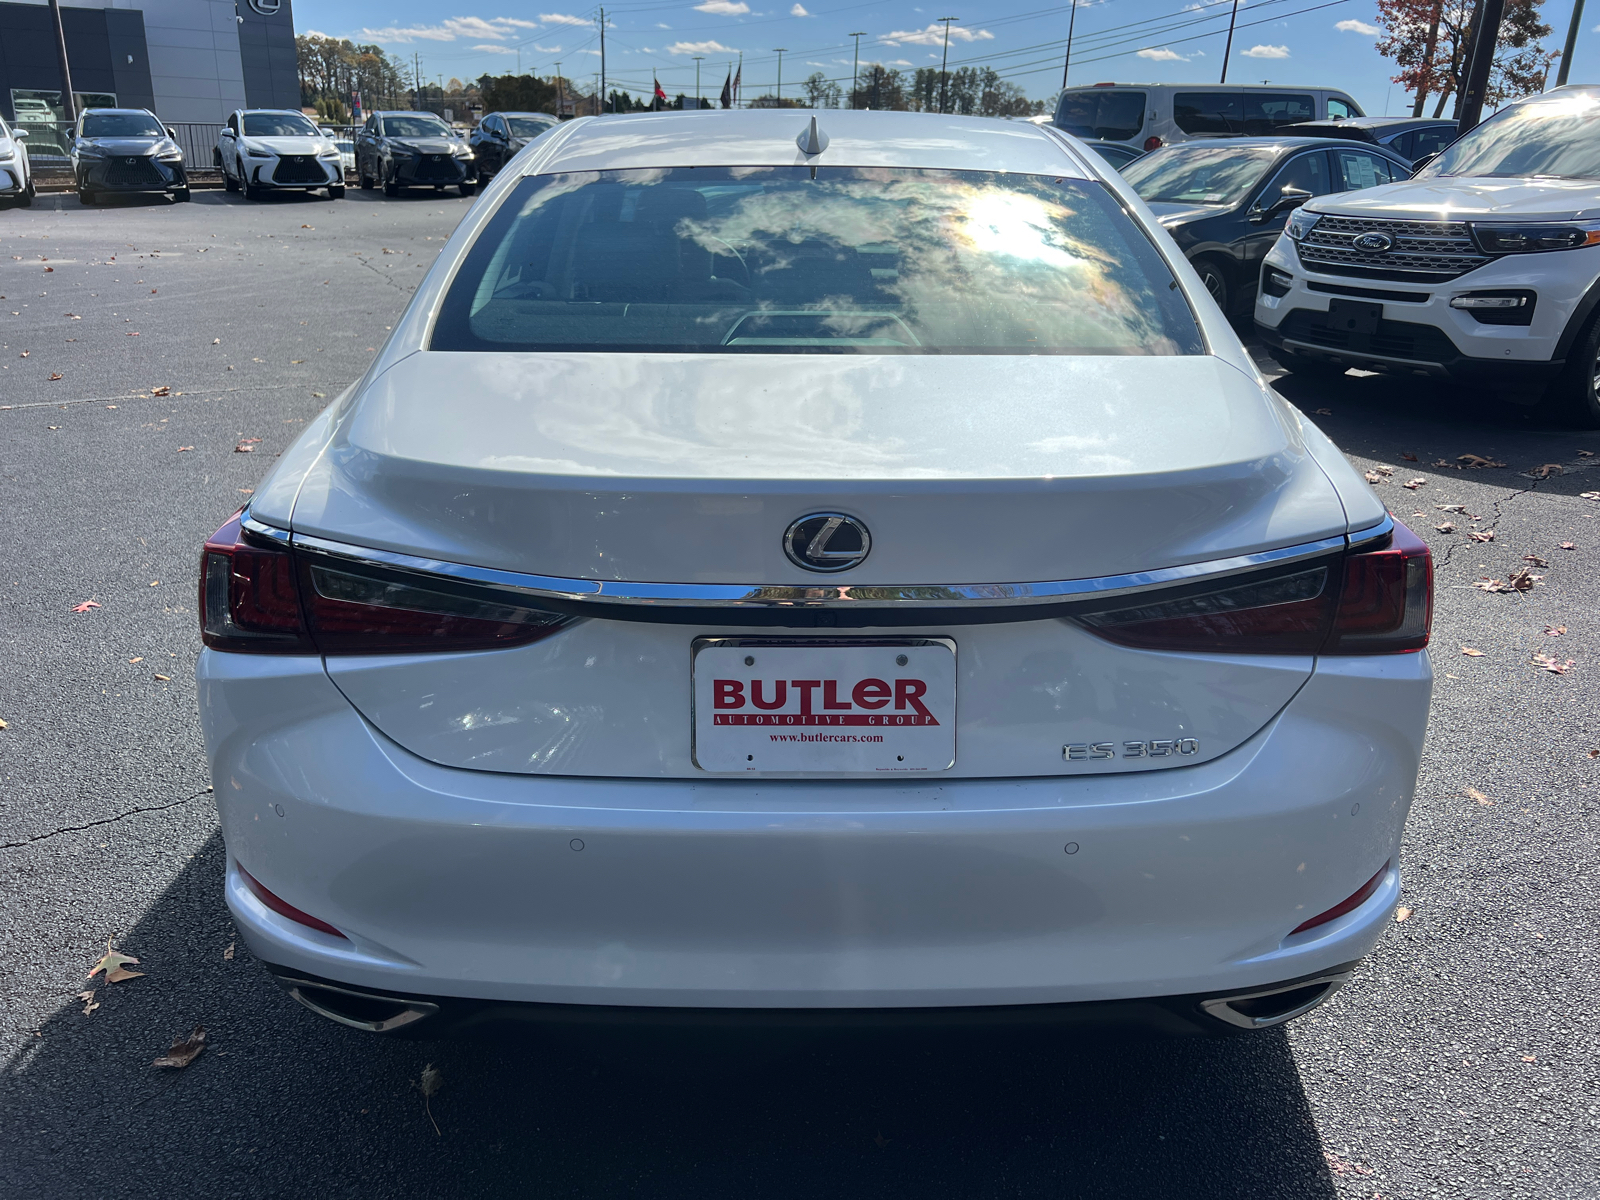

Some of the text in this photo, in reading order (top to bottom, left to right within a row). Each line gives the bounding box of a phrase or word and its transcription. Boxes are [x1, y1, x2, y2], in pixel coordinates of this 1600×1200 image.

[715, 715, 932, 725] AUTOMOTIVE GROUP
[769, 733, 884, 743] www.butlercars.com
[1062, 737, 1200, 762] ES 350
